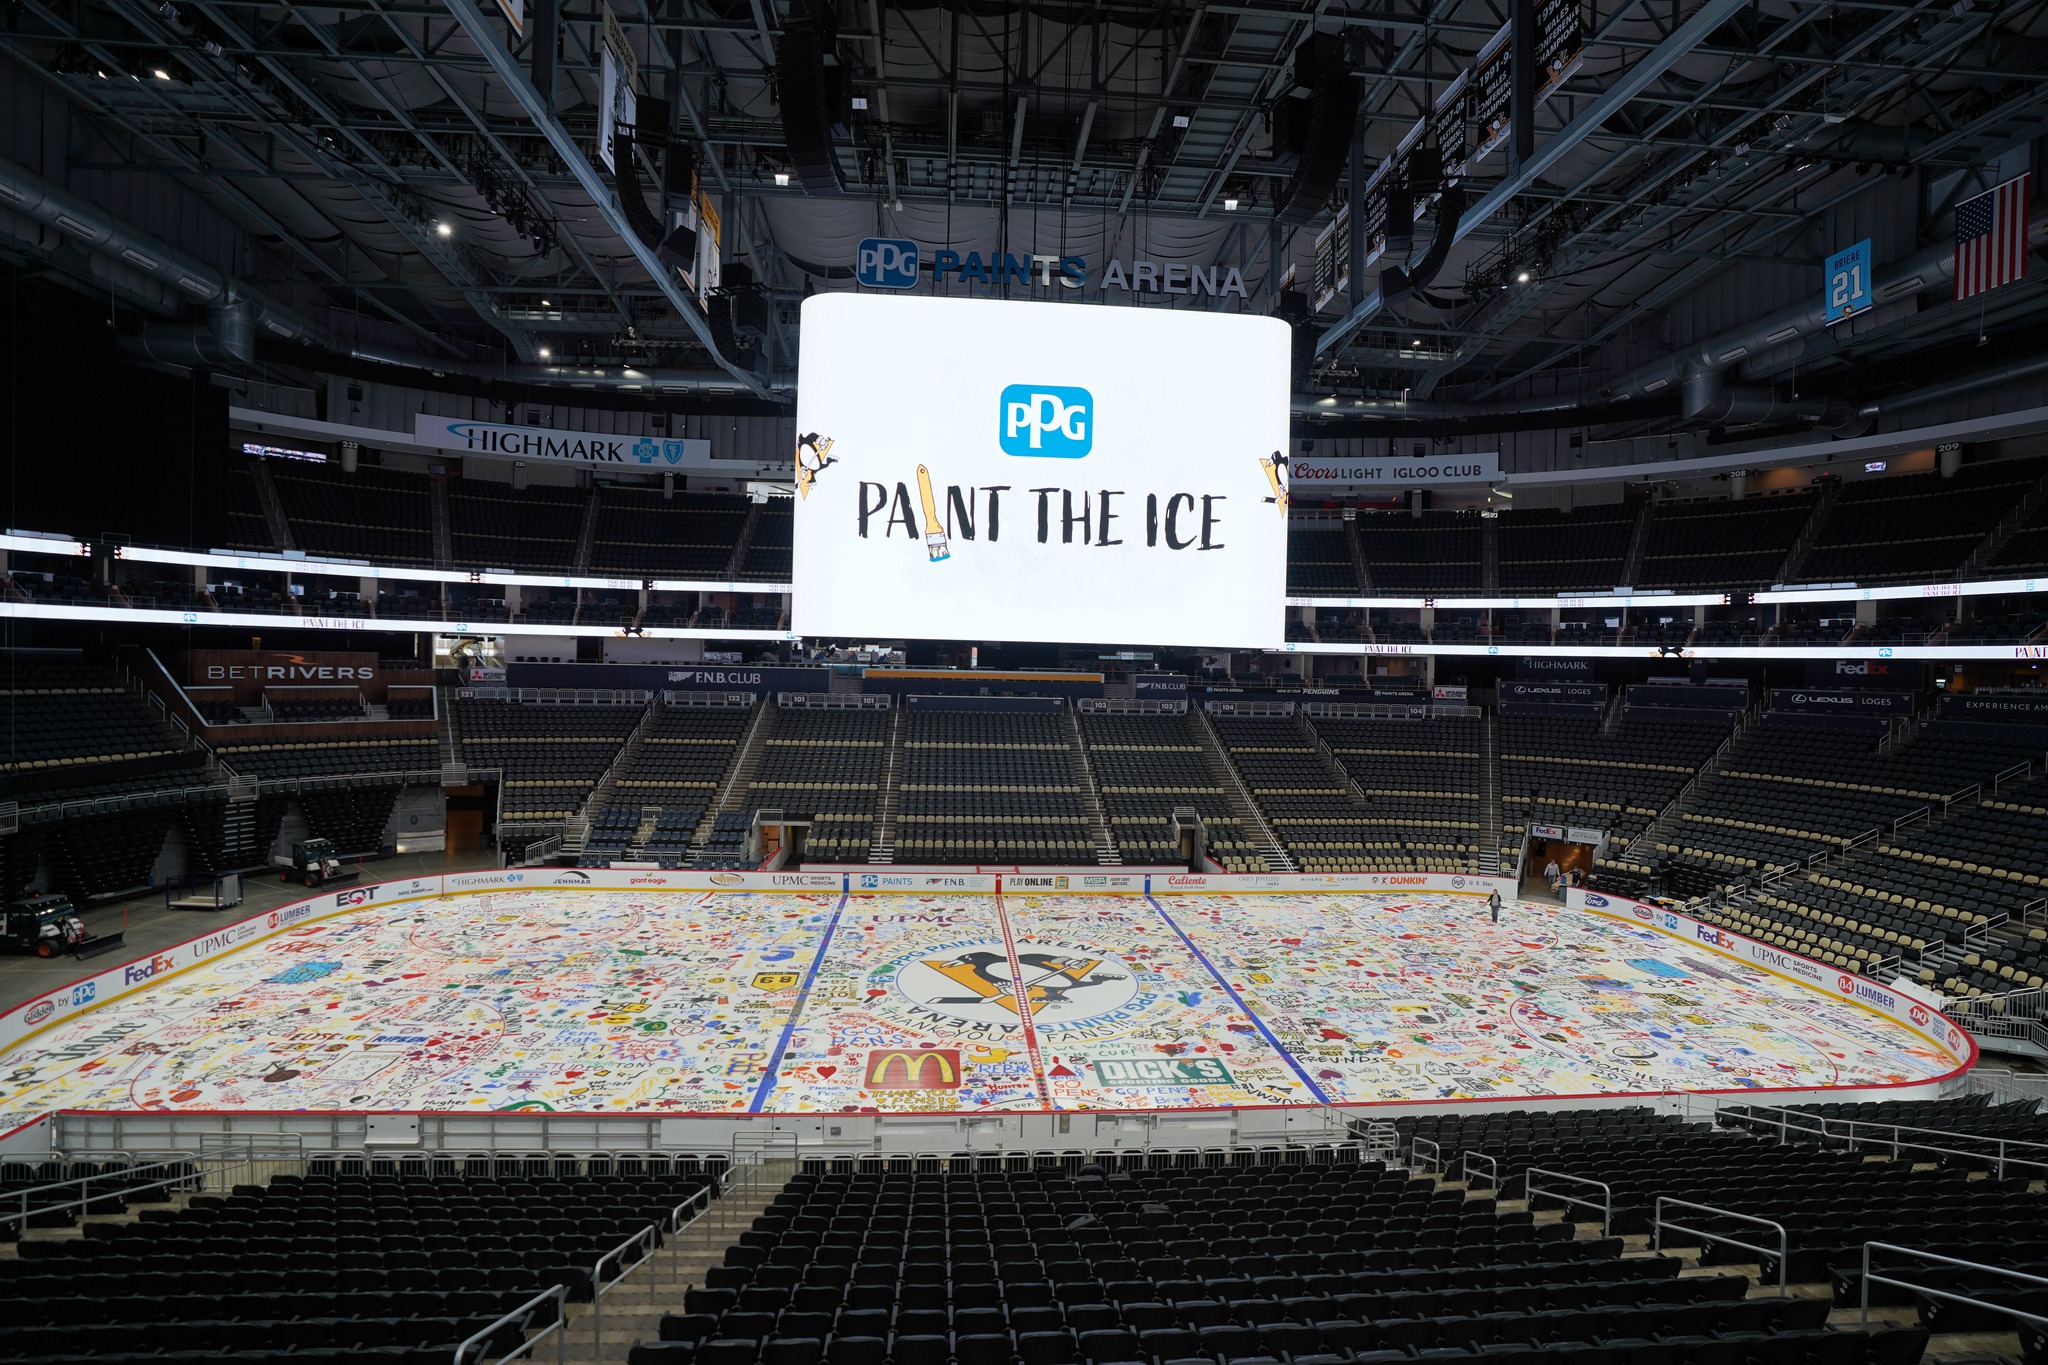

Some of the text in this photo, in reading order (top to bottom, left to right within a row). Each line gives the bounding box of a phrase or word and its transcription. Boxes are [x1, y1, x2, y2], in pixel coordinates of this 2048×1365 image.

[1545, 4, 1569, 34] WALES
[1486, 70, 1507, 96] WALES
[860, 242, 1249, 299] PPG PAINTS ARENA
[1834, 249, 1861, 271] BRIERE
[1832, 264, 1864, 309] 21
[1006, 393, 1087, 450] PPG
[341, 440, 359, 449] 232
[468, 427, 625, 463] HIGHMARK
[1937, 442, 1961, 453] 209
[1294, 462, 1483, 480] Coors LIGHT IGLOO CLUB
[1729, 469, 1747, 478] 208
[1028, 487, 1126, 548] THE
[1146, 493, 1228, 551] ICE
[207, 666, 373, 680] BETRIVERS
[1528, 660, 1589, 671] HIGHMARK
[1836, 661, 1889, 675] FedEx
[695, 671, 761, 685] F.N.B. CLUB
[461, 690, 474, 698] 121
[1302, 688, 1341, 696] PENGUINS
[1809, 697, 1892, 706] LEXUS LOGES
[1966, 701, 2031, 711] EXPERIENCE
[1536, 826, 1557, 836] FedEx
[458, 876, 505, 886] HIGHMARK
[630, 877, 647, 885] giant
[648, 877, 667, 885] eagle
[772, 875, 809, 886] UPMC
[862, 876, 877, 887] PPG
[882, 878, 913, 886] PAINTS
[1010, 878, 1024, 887] PLAY
[1024, 877, 1053, 887] ONLINE
[1085, 876, 1105, 884] MSA
[1168, 876, 1207, 886] Caliente
[337, 885, 381, 908] EQT
[280, 905, 311, 922] LUMBER
[1633, 905, 1653, 920] Glidden
[1656, 913, 1663, 922] by
[193, 930, 236, 958] UPMC
[1697, 924, 1735, 951] FedEx
[890, 936, 1108, 967] PPG PAINTS ARENA
[1752, 945, 1817, 973] UPMC SPORTS
[125, 953, 175, 986] FedEx
[1793, 966, 1823, 982] MEDICINE
[24, 983, 95, 1025] Glidden by PPG
[1856, 983, 1895, 1008] LUMBER
[907, 1006, 1019, 1033] ARENA
[1036, 992, 1159, 1034] PPG PAINTS
[1912, 1007, 1928, 1026] DQ
[877, 1009, 941, 1036] THANK
[953, 1029, 1006, 1043] YOU
[1103, 1059, 1224, 1080] DICK'S
